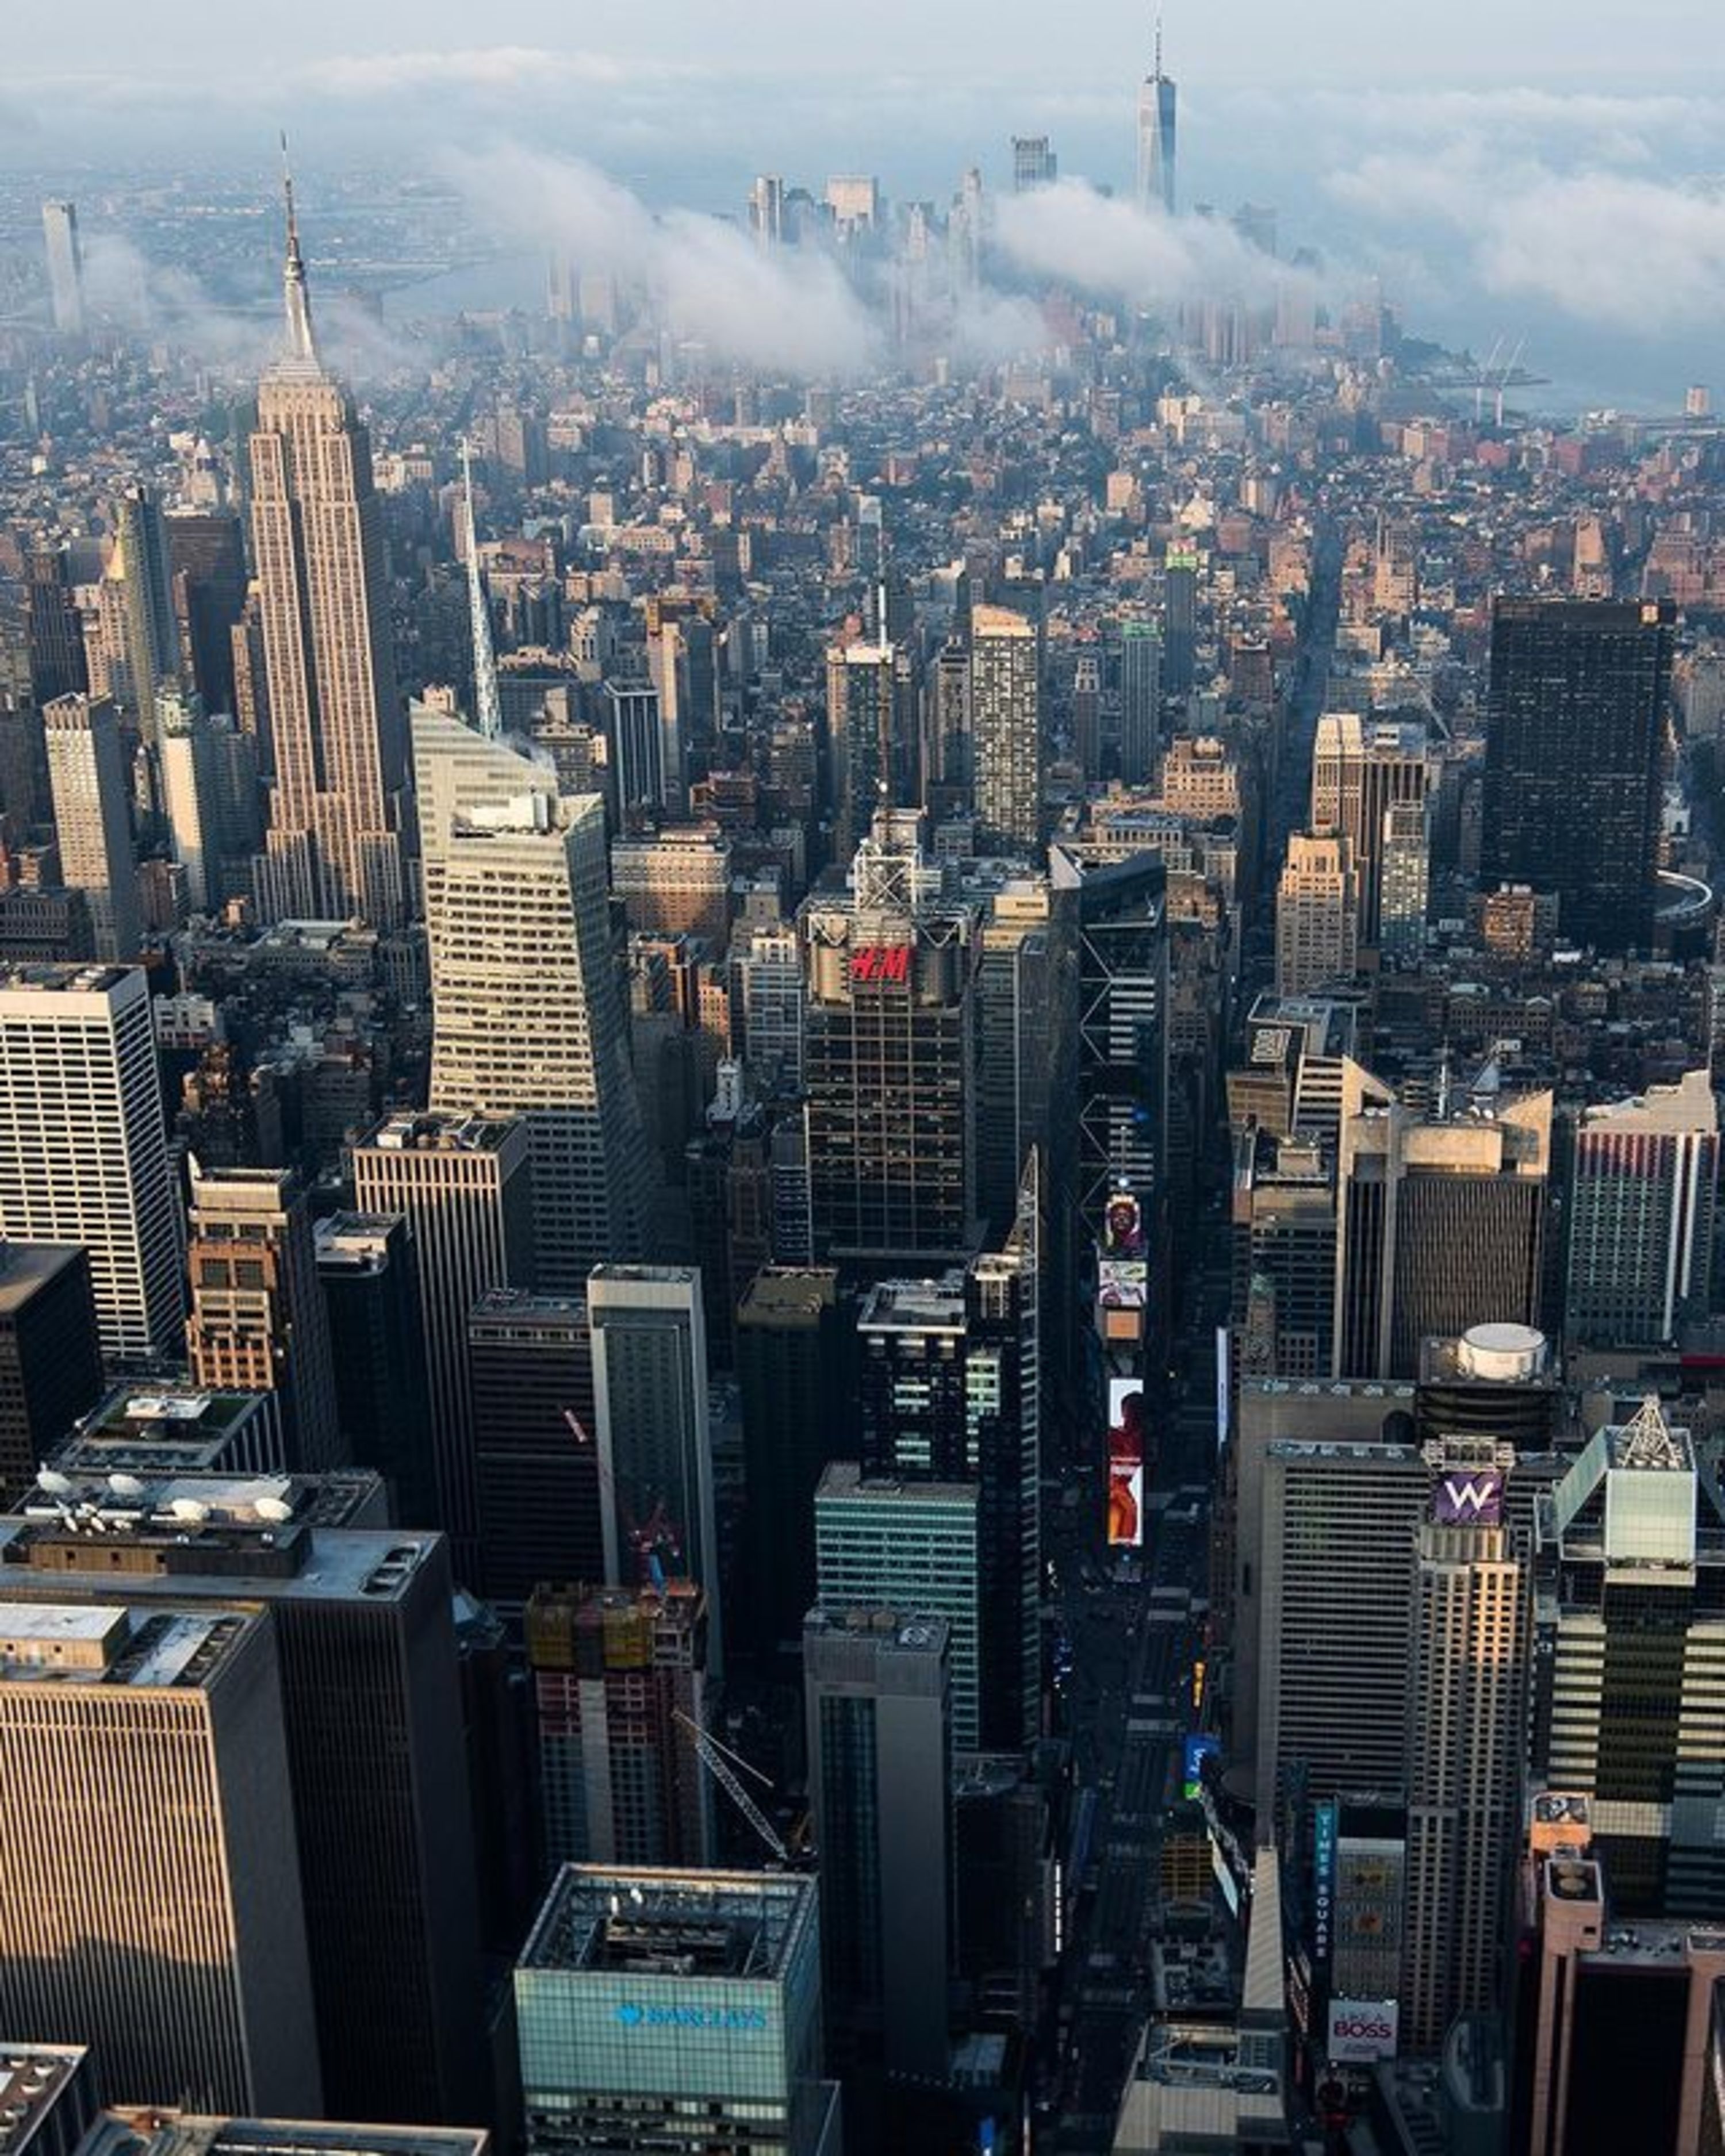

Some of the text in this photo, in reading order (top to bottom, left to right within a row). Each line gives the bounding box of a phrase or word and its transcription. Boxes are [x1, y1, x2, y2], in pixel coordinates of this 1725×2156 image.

[1444, 1481, 1494, 1511] W
[1316, 1813, 1332, 1958] TIMES SQUARE
[647, 2006, 766, 2027] BARCLAYS
[1334, 2021, 1392, 2039] BOSS
